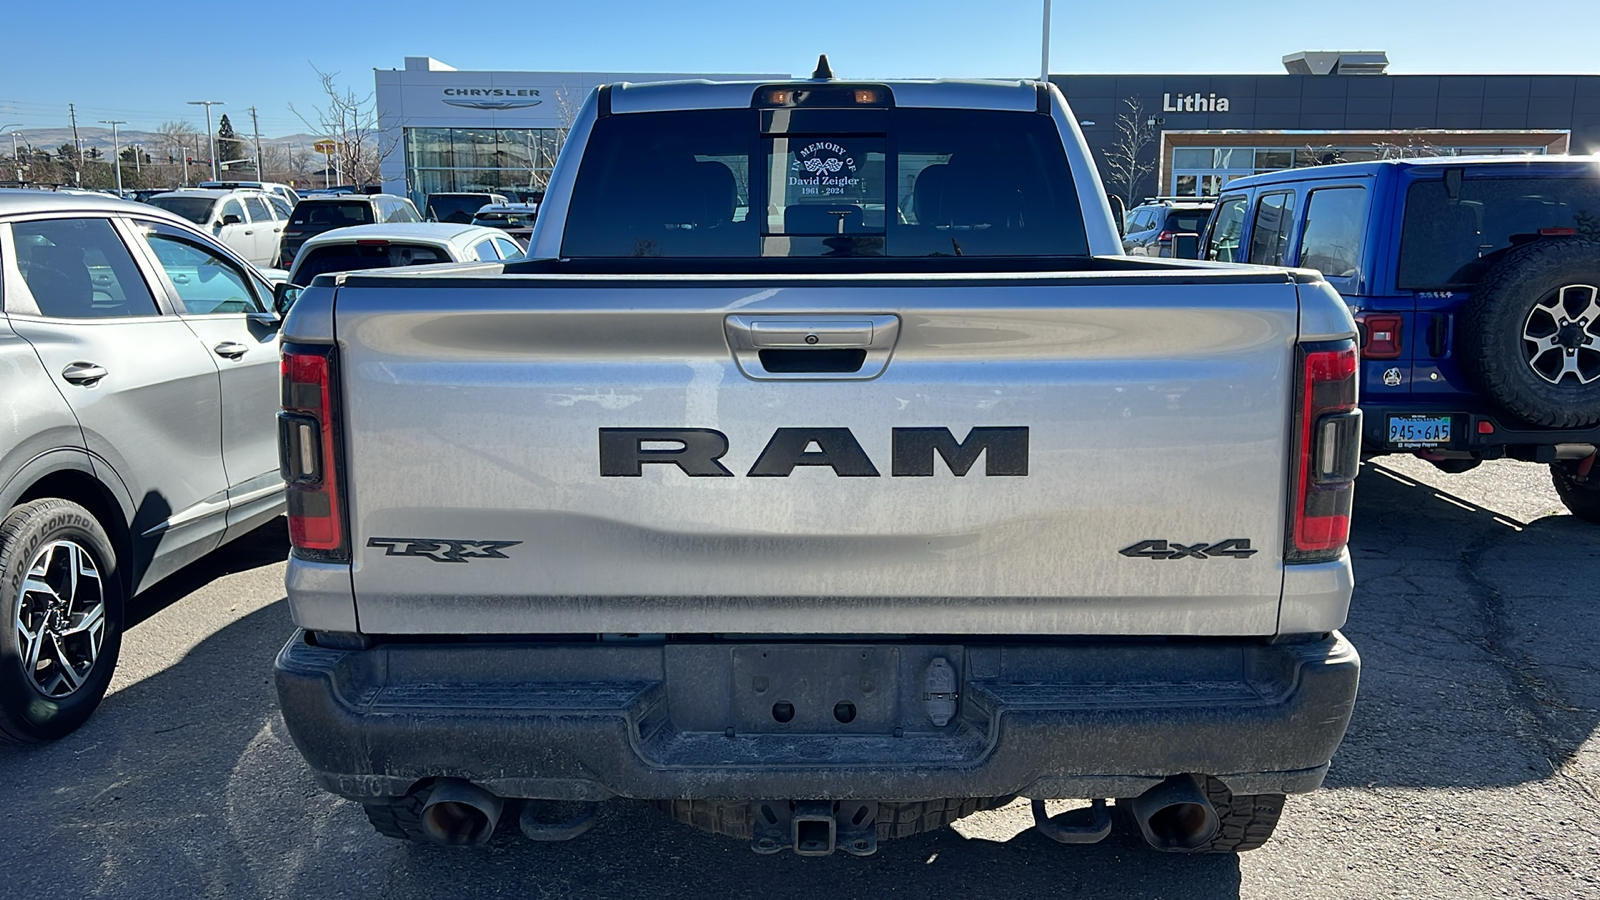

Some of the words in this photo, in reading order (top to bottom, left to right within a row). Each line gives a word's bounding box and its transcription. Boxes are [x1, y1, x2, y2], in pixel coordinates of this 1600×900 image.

[443, 88, 541, 97] CHRYSLER
[1163, 93, 1229, 112] Lithia
[791, 159, 801, 172] IN
[800, 142, 847, 158] MEMORY
[846, 157, 857, 173] OF
[789, 176, 819, 186] David
[822, 176, 859, 187] Zeigler
[599, 426, 1030, 477] RAM
[12, 534, 38, 591] ROAD
[41, 514, 96, 537] CONTROL
[366, 537, 524, 563] TRX
[1118, 538, 1258, 559] 4x4
